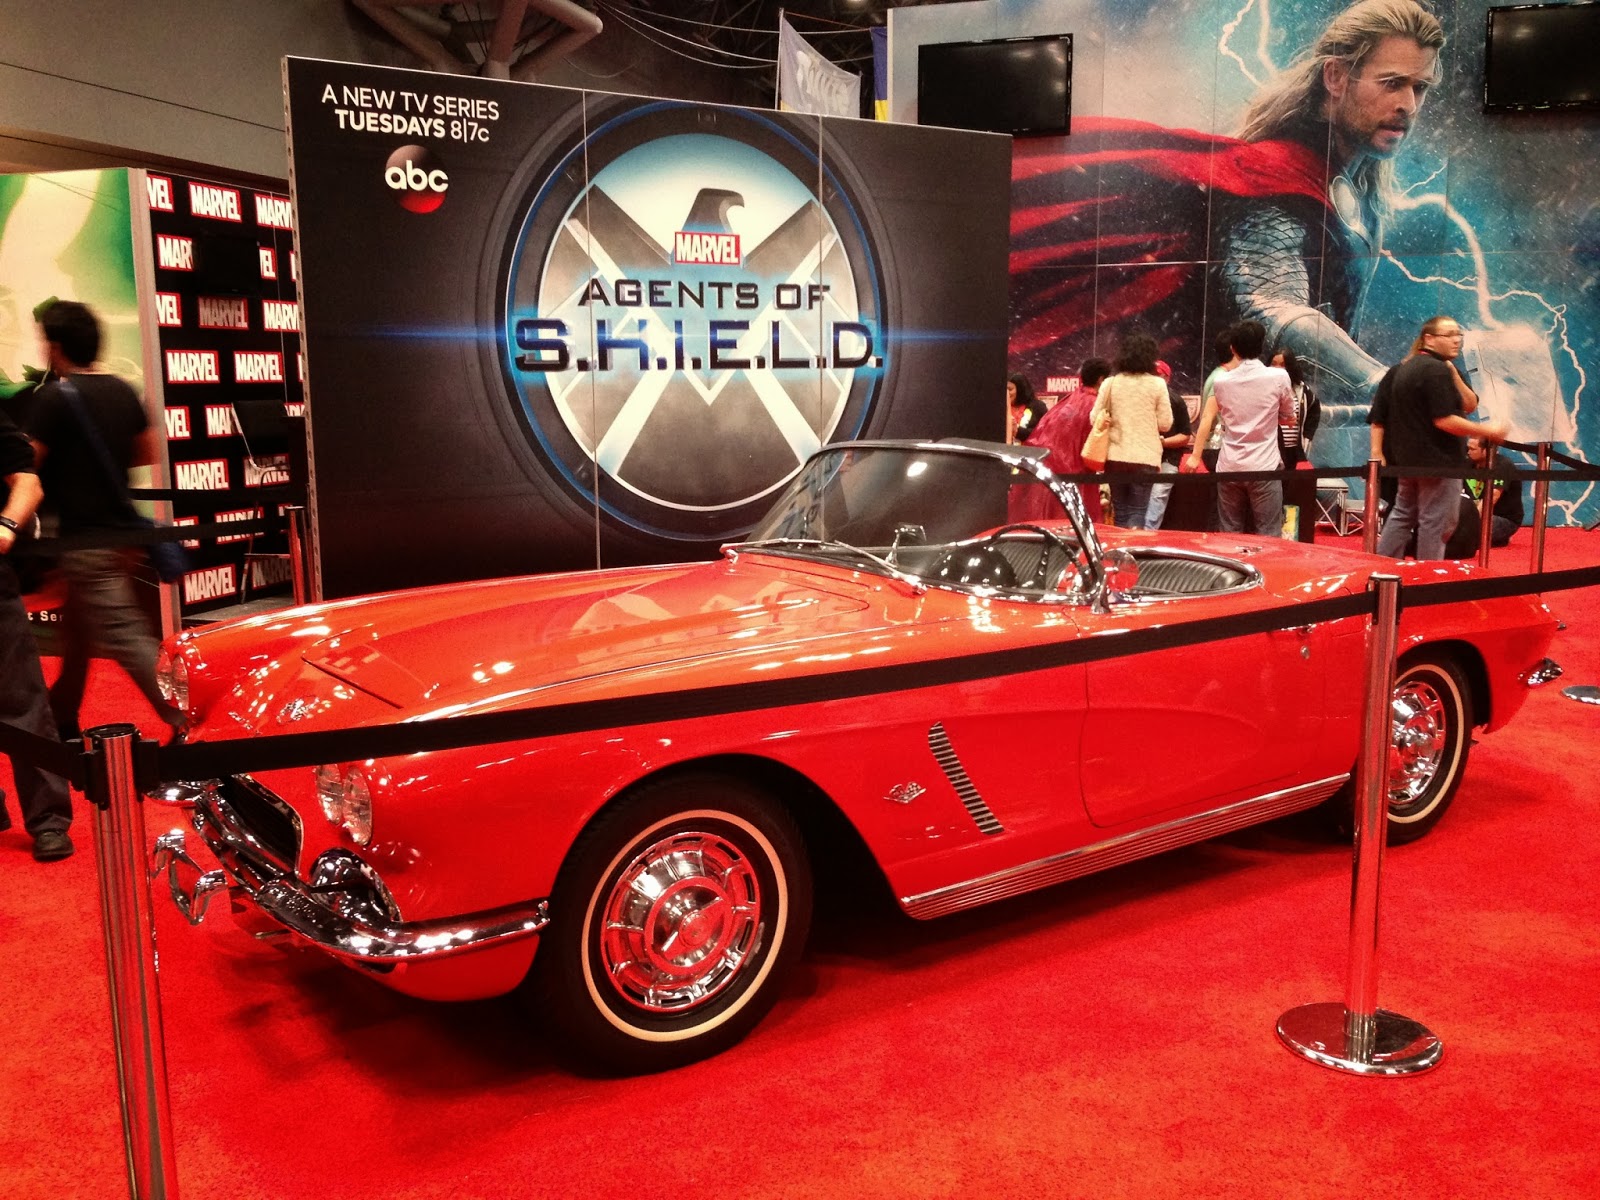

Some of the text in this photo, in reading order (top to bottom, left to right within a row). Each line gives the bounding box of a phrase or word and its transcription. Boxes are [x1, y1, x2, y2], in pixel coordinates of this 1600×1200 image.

[321, 84, 500, 121] A NEW TV SERIES
[335, 109, 446, 139] TUESDAYS
[385, 160, 449, 193] abc
[147, 177, 293, 229] VEL MARVEL MARV
[159, 237, 193, 270] MAR
[676, 234, 739, 264] MARVEL
[577, 278, 830, 311] AGENTS OF
[156, 295, 300, 331] VEL MARVEL MARV
[515, 318, 884, 373] S.H.I.E.L.D.
[168, 352, 219, 382] MARVEL
[235, 354, 284, 381] MARVEL
[165, 408, 190, 438] VEL
[176, 461, 229, 490] MARVEL
[184, 566, 236, 603] MARVEL
